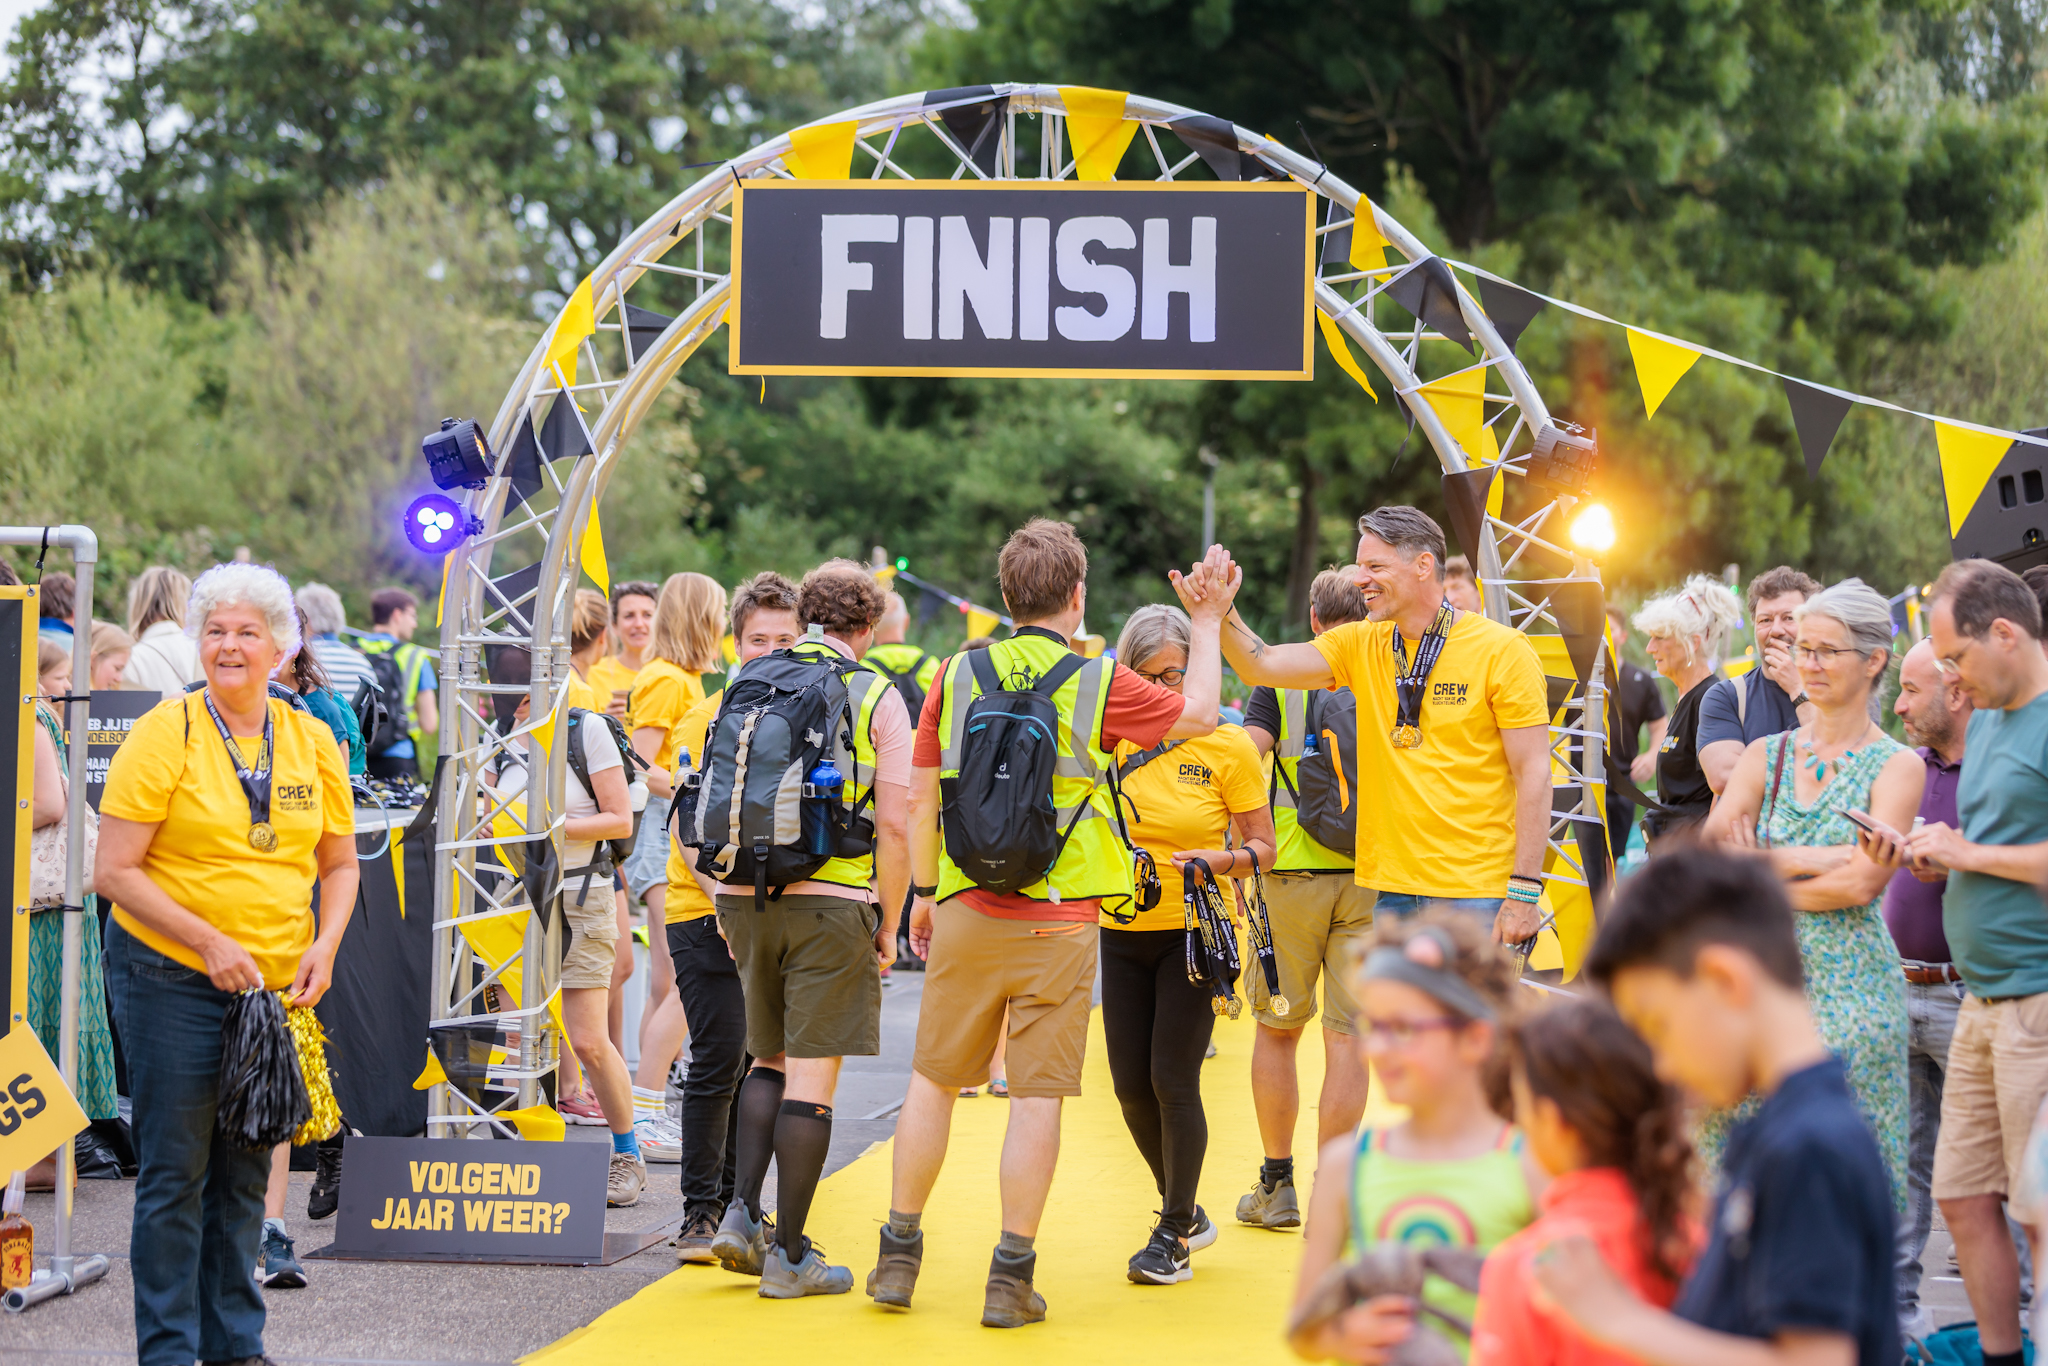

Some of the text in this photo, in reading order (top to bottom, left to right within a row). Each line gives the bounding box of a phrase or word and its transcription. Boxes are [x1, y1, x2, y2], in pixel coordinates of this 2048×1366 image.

[820, 214, 1217, 343] FINISH
[1434, 683, 1468, 695] CREW
[87, 718, 102, 731] EB
[102, 718, 120, 731] JIJ
[1179, 764, 1213, 779] CREW
[409, 1161, 541, 1195] VOLGEND
[371, 1198, 570, 1234] JAAR WEER?
